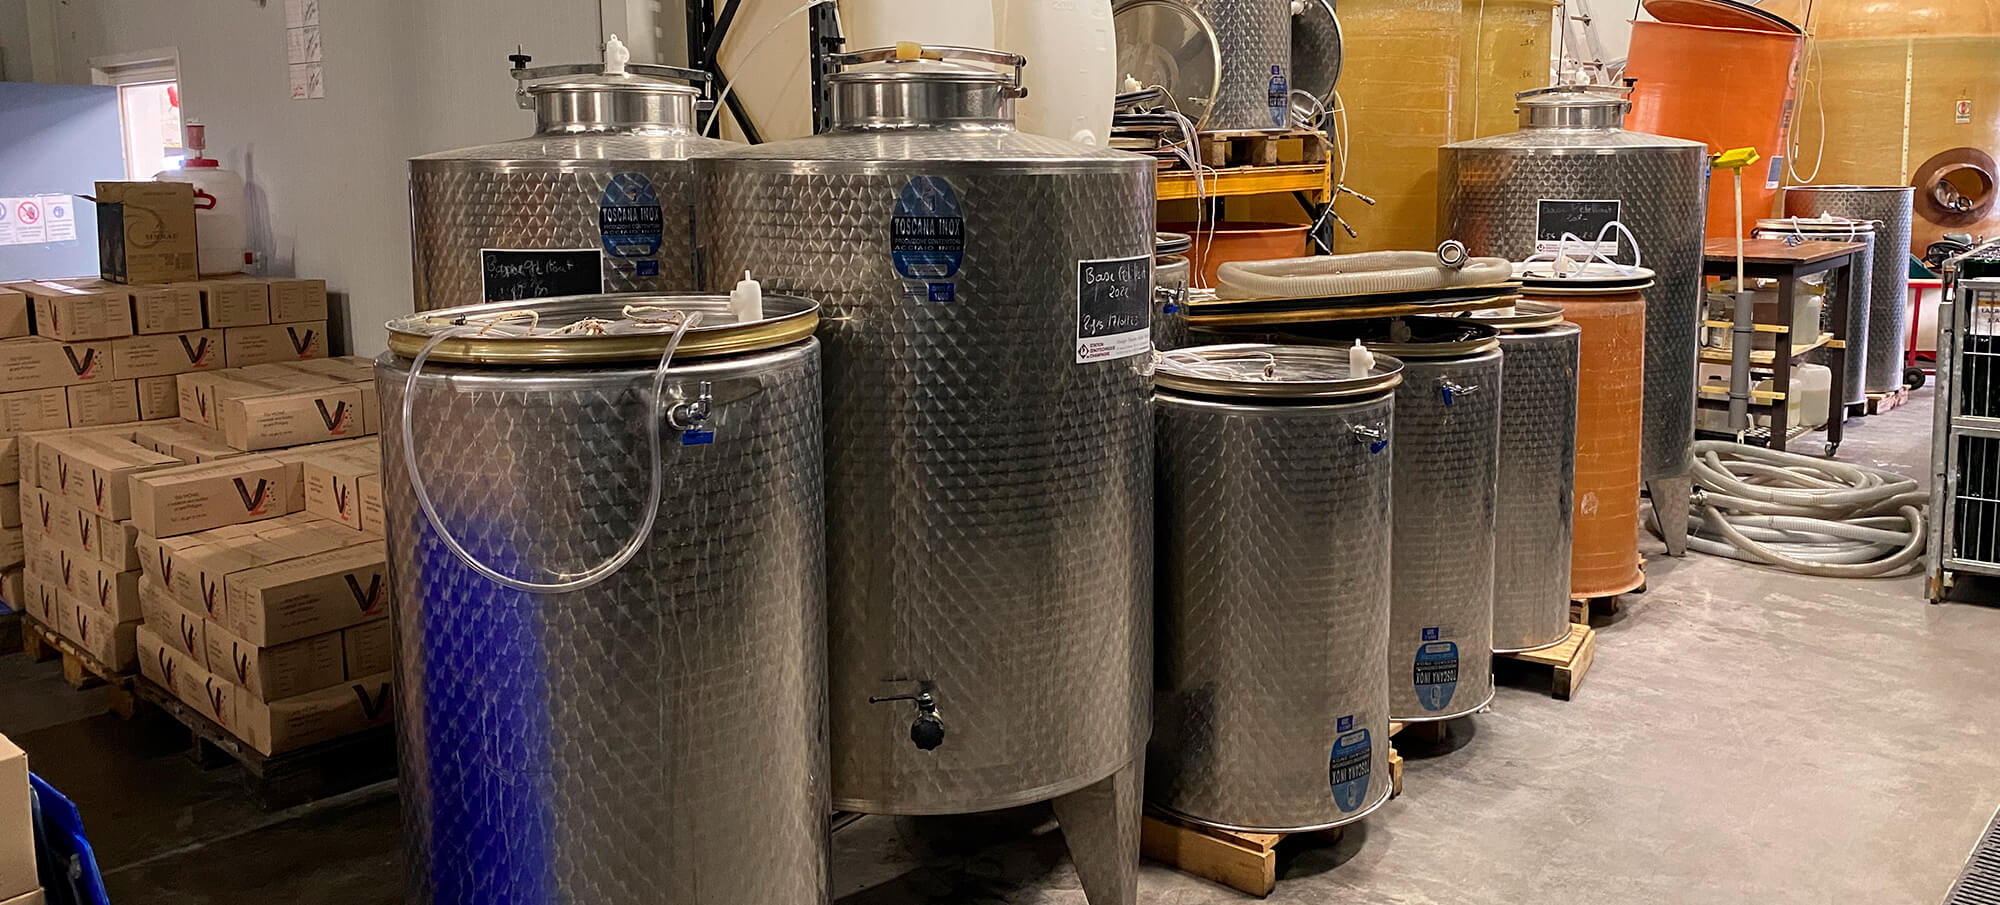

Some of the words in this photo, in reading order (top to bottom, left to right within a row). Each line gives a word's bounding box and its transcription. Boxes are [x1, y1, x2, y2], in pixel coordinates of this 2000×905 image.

[602, 207, 638, 222] TOSCANA
[640, 207, 660, 222] INOX
[894, 218, 936, 235] TOSCANA
[939, 218, 961, 235] INOX
[1085, 266, 1115, 284] Base
[1415, 671, 1431, 684] INOX
[1432, 670, 1457, 683] TOSCANA
[1331, 767, 1347, 784] INOX
